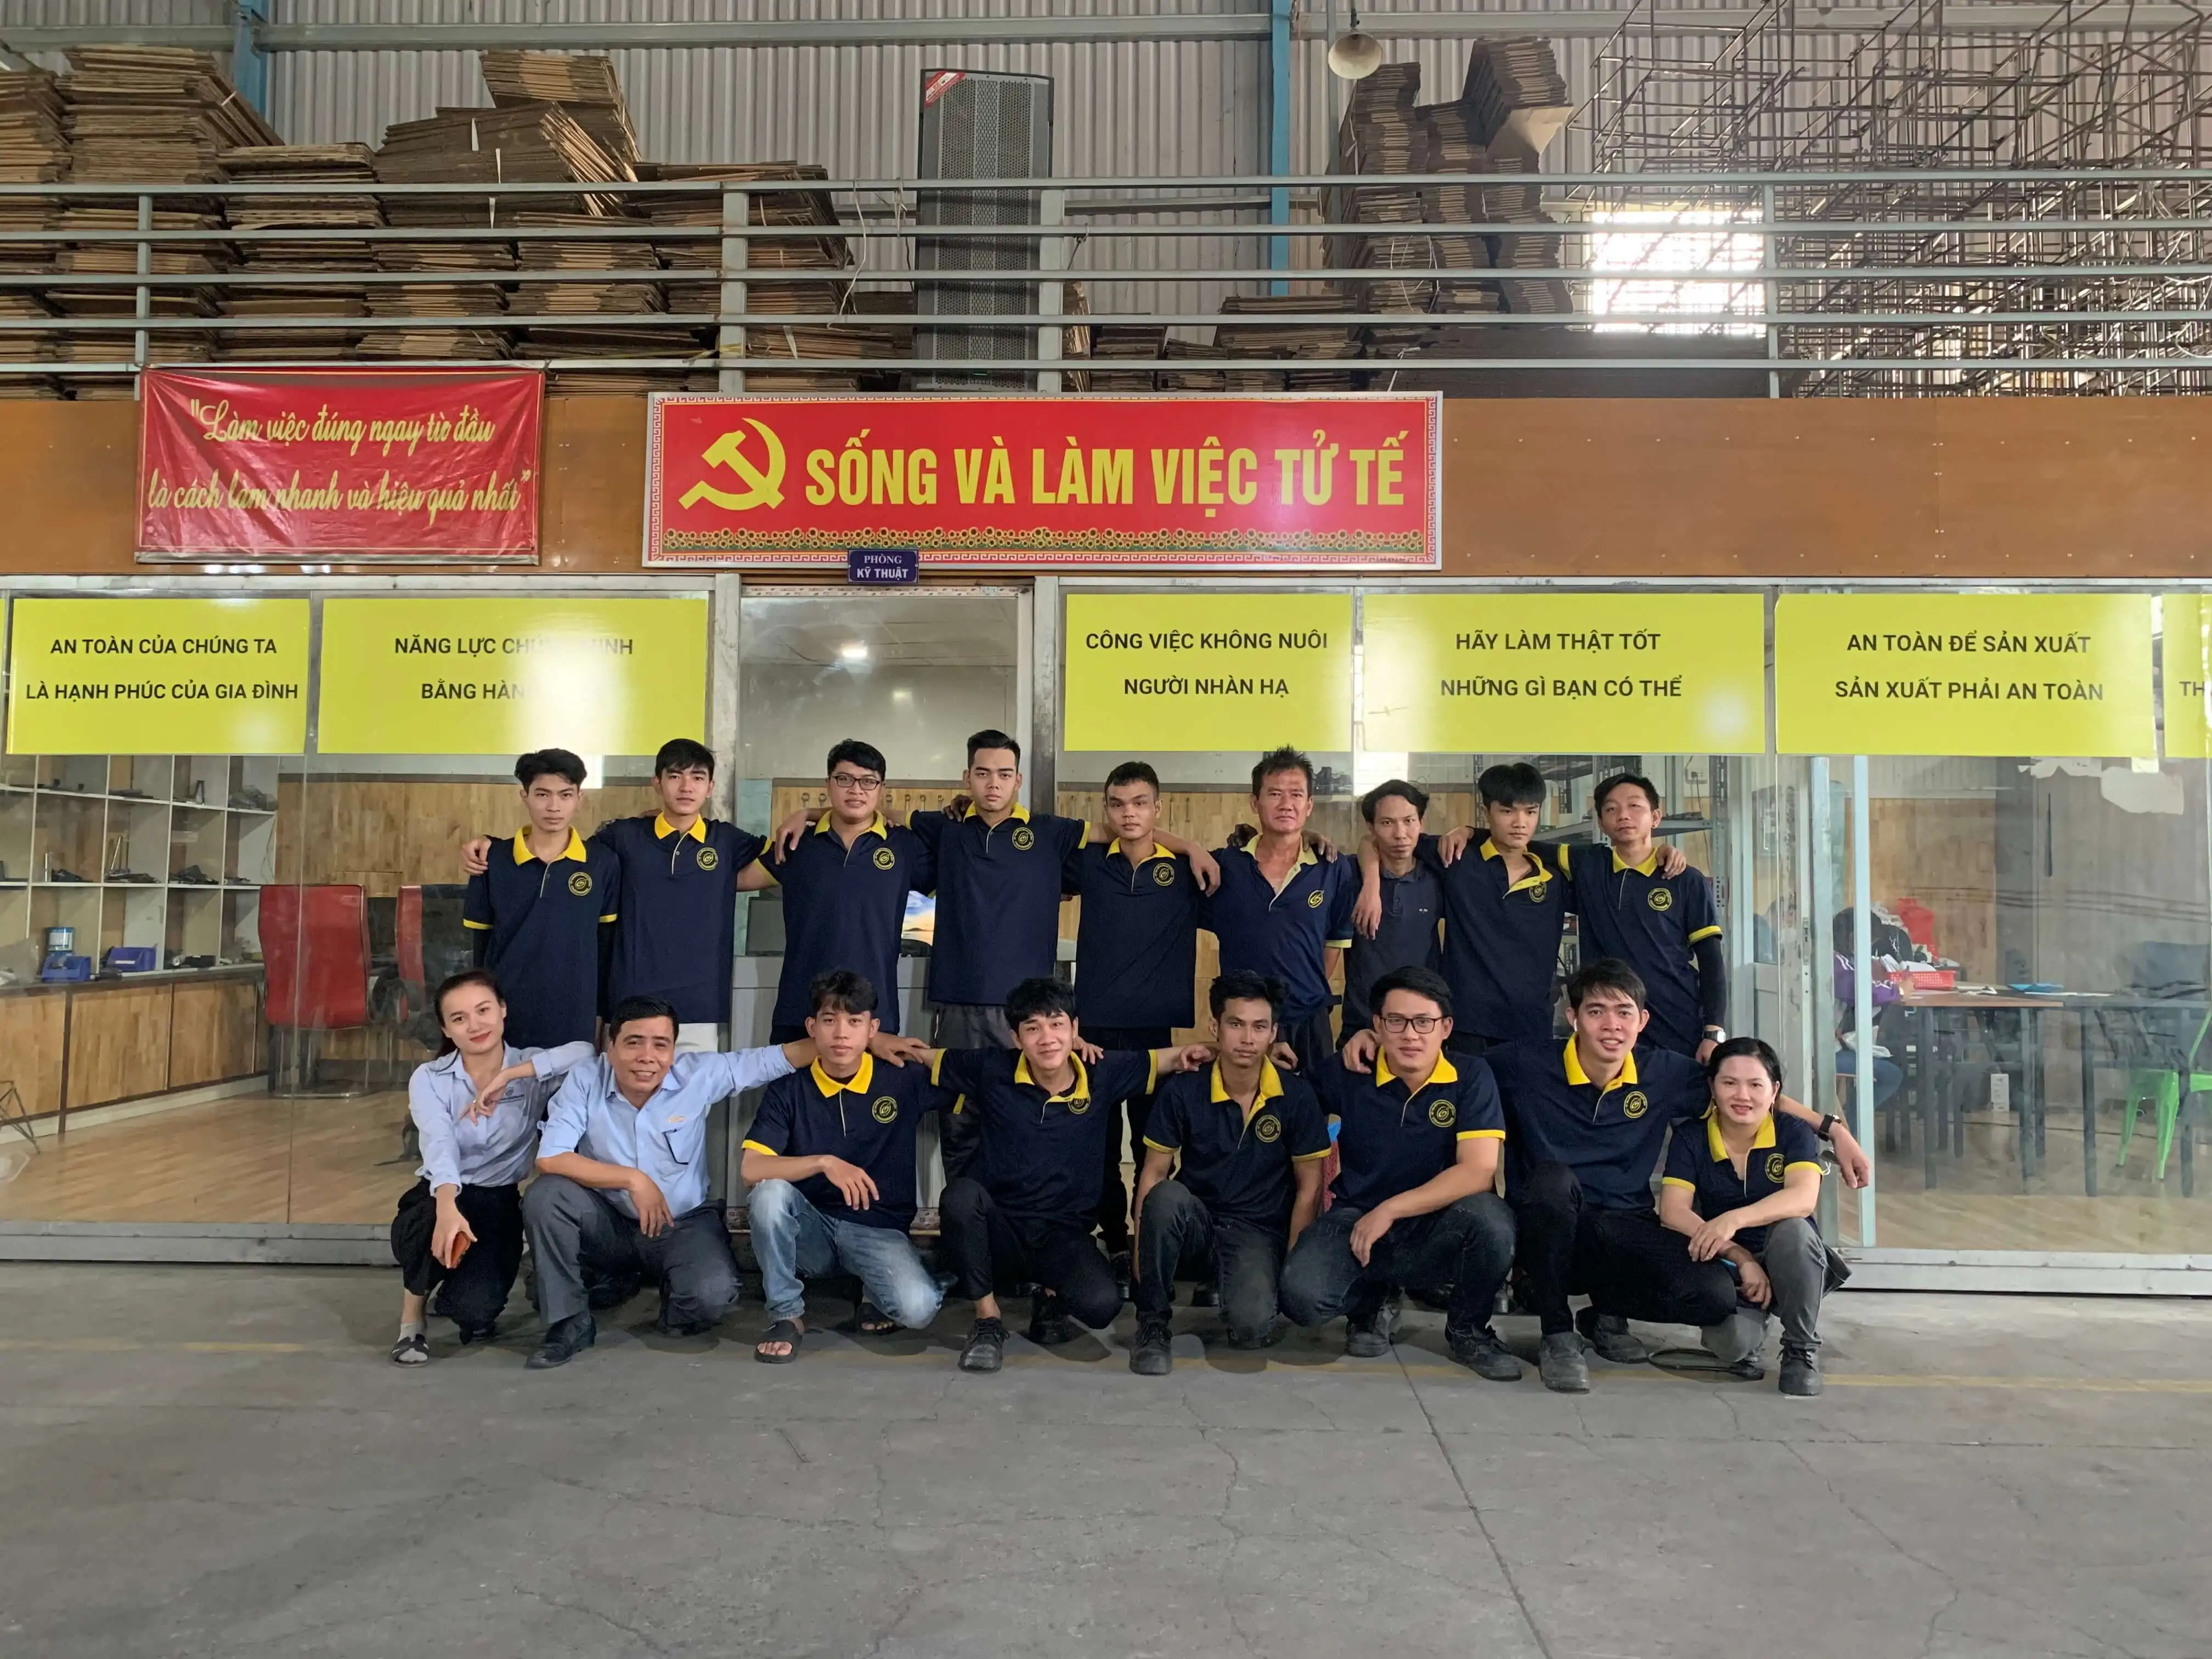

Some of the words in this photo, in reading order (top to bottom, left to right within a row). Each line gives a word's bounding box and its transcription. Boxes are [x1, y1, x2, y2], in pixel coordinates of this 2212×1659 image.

[267, 410, 310, 447] việc
[312, 404, 367, 456] đúng
[369, 420, 424, 457] ngay
[427, 411, 452, 442] từ
[453, 404, 496, 442] đầu
[805, 428, 937, 506] SỐNG
[953, 436, 1015, 504] VÀ
[1032, 436, 1134, 505] LÀM
[1150, 436, 1257, 517] VIỆC
[1274, 429, 1339, 506] TỬ
[1350, 430, 1409, 505] TẾ
[148, 469, 172, 508] là
[174, 469, 224, 508] cách
[228, 469, 273, 510] làm
[276, 469, 343, 511] nhanh
[347, 481, 376, 511] và
[377, 470, 426, 516] hiệu
[427, 479, 469, 528] quả
[864, 553, 902, 564] PHÒNG
[857, 566, 871, 579] KỸ
[873, 566, 909, 581] THUẬT
[50, 639, 77, 654] AN
[82, 635, 133, 654] TOÀN
[138, 634, 177, 654] CỦA
[182, 635, 249, 654] CHÚNG
[253, 638, 278, 654] TA
[394, 634, 452, 654] NĂNG
[457, 637, 496, 658] LỰC
[1086, 629, 1143, 650] CÔNG
[1148, 629, 1194, 653] VIỆC
[1200, 629, 1272, 650] KHÔNG
[1278, 628, 1328, 649] NUÔI
[1455, 629, 1499, 650] HÃY
[1505, 629, 1551, 650] LÀM
[1556, 629, 1615, 654] THẬT
[1618, 628, 1661, 650] TỐT
[1846, 634, 1877, 651] AN
[1883, 630, 1943, 652] TOÀN
[1948, 629, 1978, 653] ĐỂ
[1983, 630, 2027, 653] SẢN
[2034, 631, 2091, 653] XUẤT
[26, 680, 49, 699] LÀ
[54, 683, 109, 703] HẠNH
[114, 680, 166, 699] PHÚC
[171, 679, 210, 699] CỦA
[215, 684, 247, 699] GIA
[252, 680, 298, 699] ĐÌNH
[421, 678, 477, 699] BẰNG
[1124, 674, 1189, 696] NGƯỜI
[1195, 674, 1254, 695] NHÀN
[1260, 678, 1290, 698] HẠ
[1440, 675, 1519, 697] NHỮNG
[1525, 675, 1545, 697] GÌ
[1553, 680, 1597, 701] BẠN
[1604, 675, 1633, 697] CÓ
[1638, 674, 1683, 697] THỂ
[1835, 675, 1879, 698] SẢN
[1885, 676, 1943, 699] XUẤT
[1948, 676, 2000, 699] PHẢI
[2006, 682, 2037, 700] AN
[2042, 678, 2103, 701] TOÀN
[2179, 681, 2205, 697] TH
